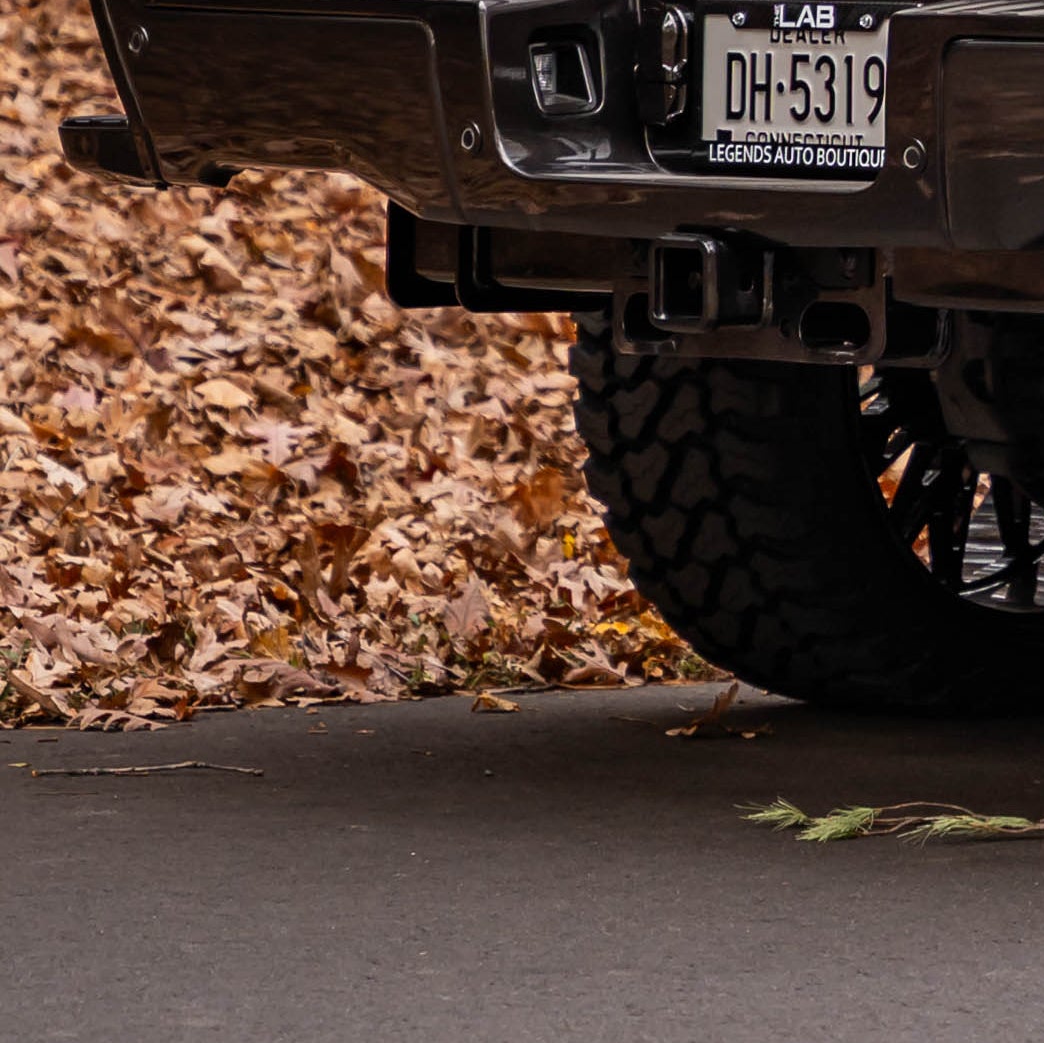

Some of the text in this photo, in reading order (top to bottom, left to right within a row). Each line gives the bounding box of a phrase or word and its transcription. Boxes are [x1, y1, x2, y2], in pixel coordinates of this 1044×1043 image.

[779, 4, 835, 29] LAB
[709, 143, 772, 164] LEGENDS
[773, 146, 814, 166] AUTO
